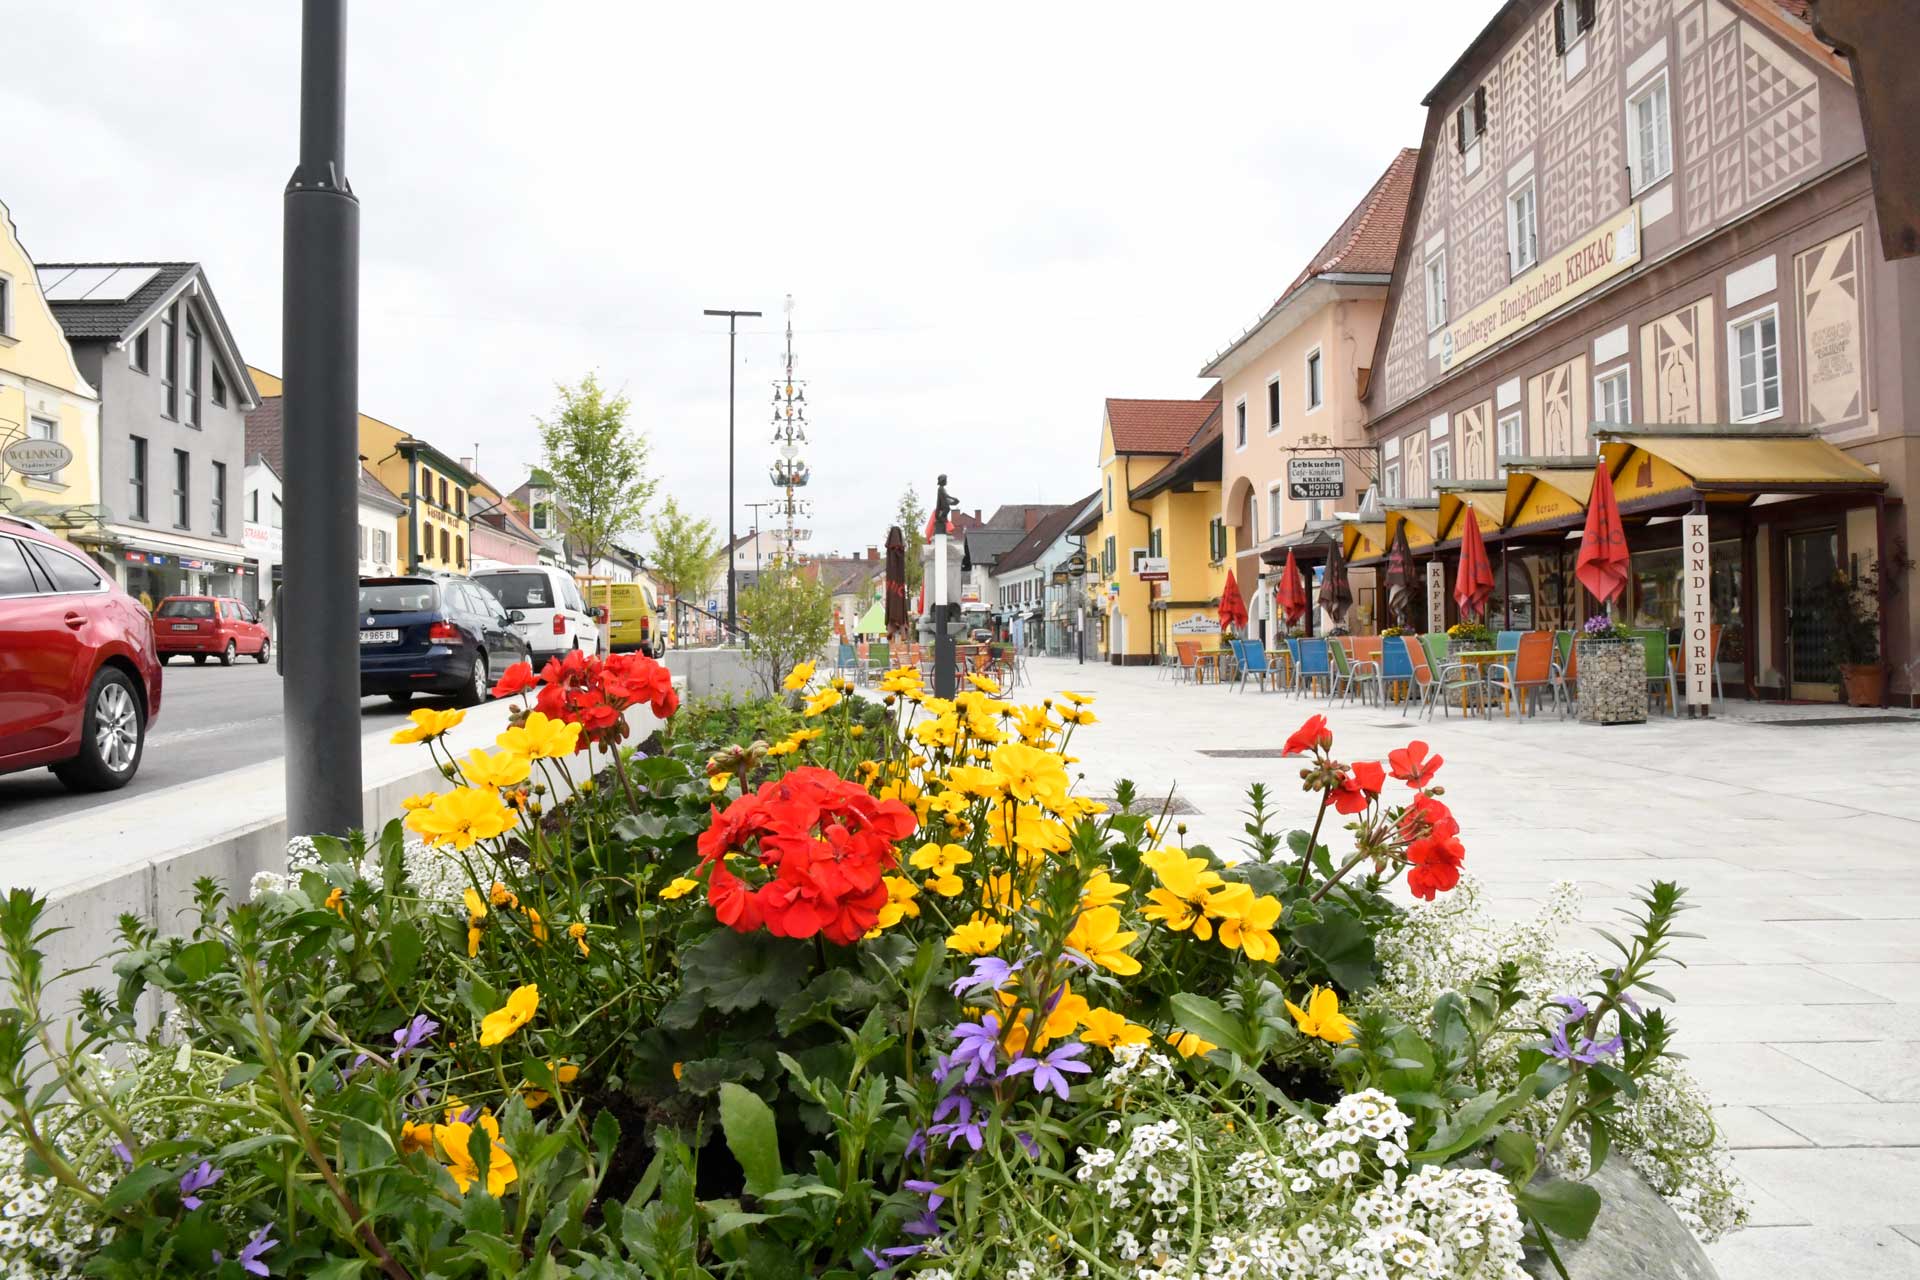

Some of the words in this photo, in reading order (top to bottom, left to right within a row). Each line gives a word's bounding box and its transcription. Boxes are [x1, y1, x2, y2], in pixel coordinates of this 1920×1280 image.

[1454, 316, 1498, 354] Kindberger
[1500, 272, 1562, 326] Honigkuchen
[1566, 231, 1614, 287] KRIKAC
[1292, 461, 1341, 469] Lebkuchen
[1309, 483, 1340, 491] HORNIG
[1431, 568, 1442, 633] KAFFEE
[1691, 524, 1707, 693] KONDITOREI
